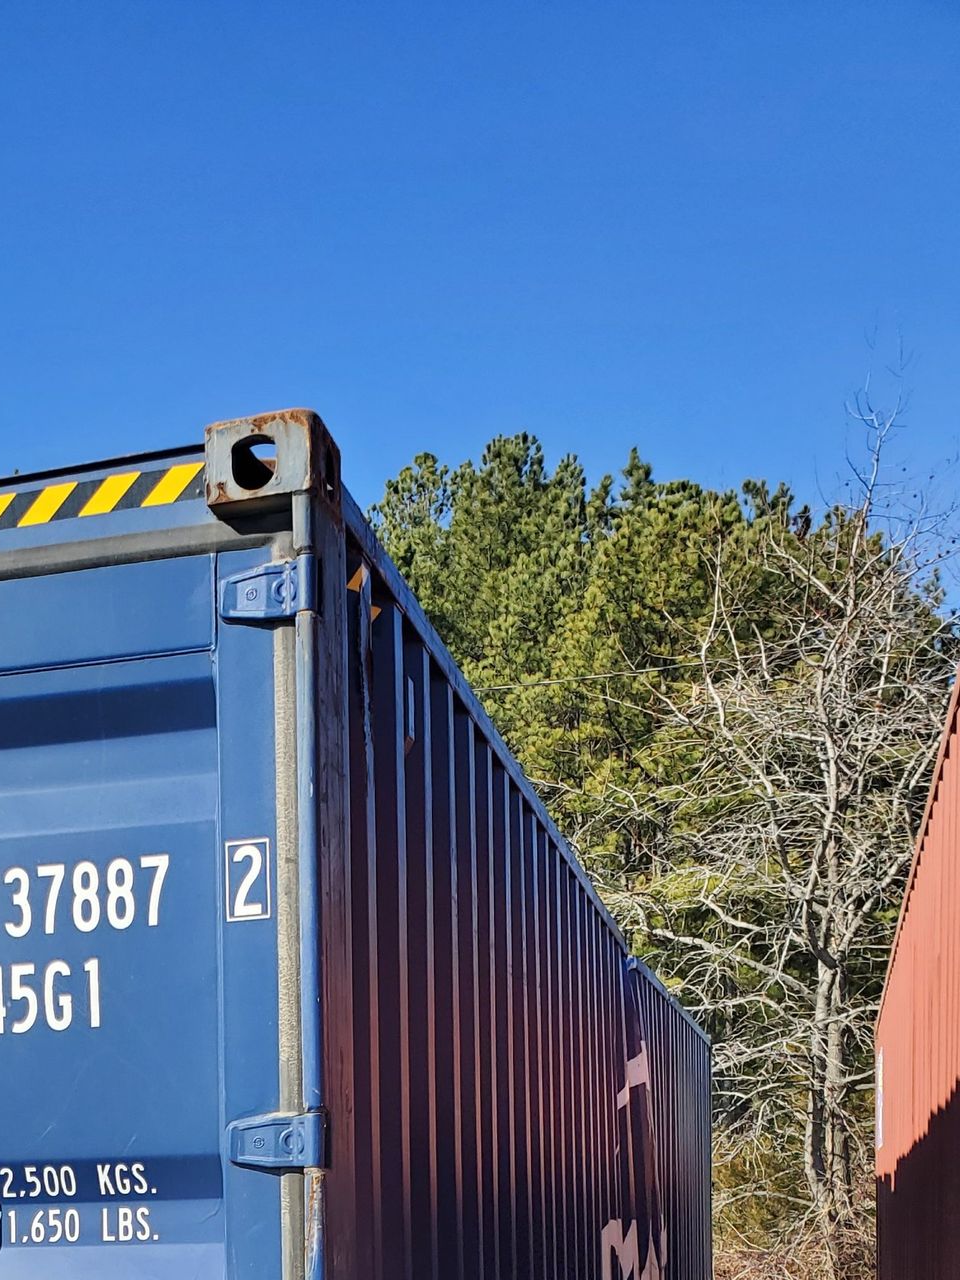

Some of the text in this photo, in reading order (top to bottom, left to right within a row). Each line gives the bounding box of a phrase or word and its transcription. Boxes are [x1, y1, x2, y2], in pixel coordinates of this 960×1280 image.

[232, 844, 262, 917] 2
[96, 1163, 158, 1195] KGS.
[102, 1207, 159, 1241] LBS.
